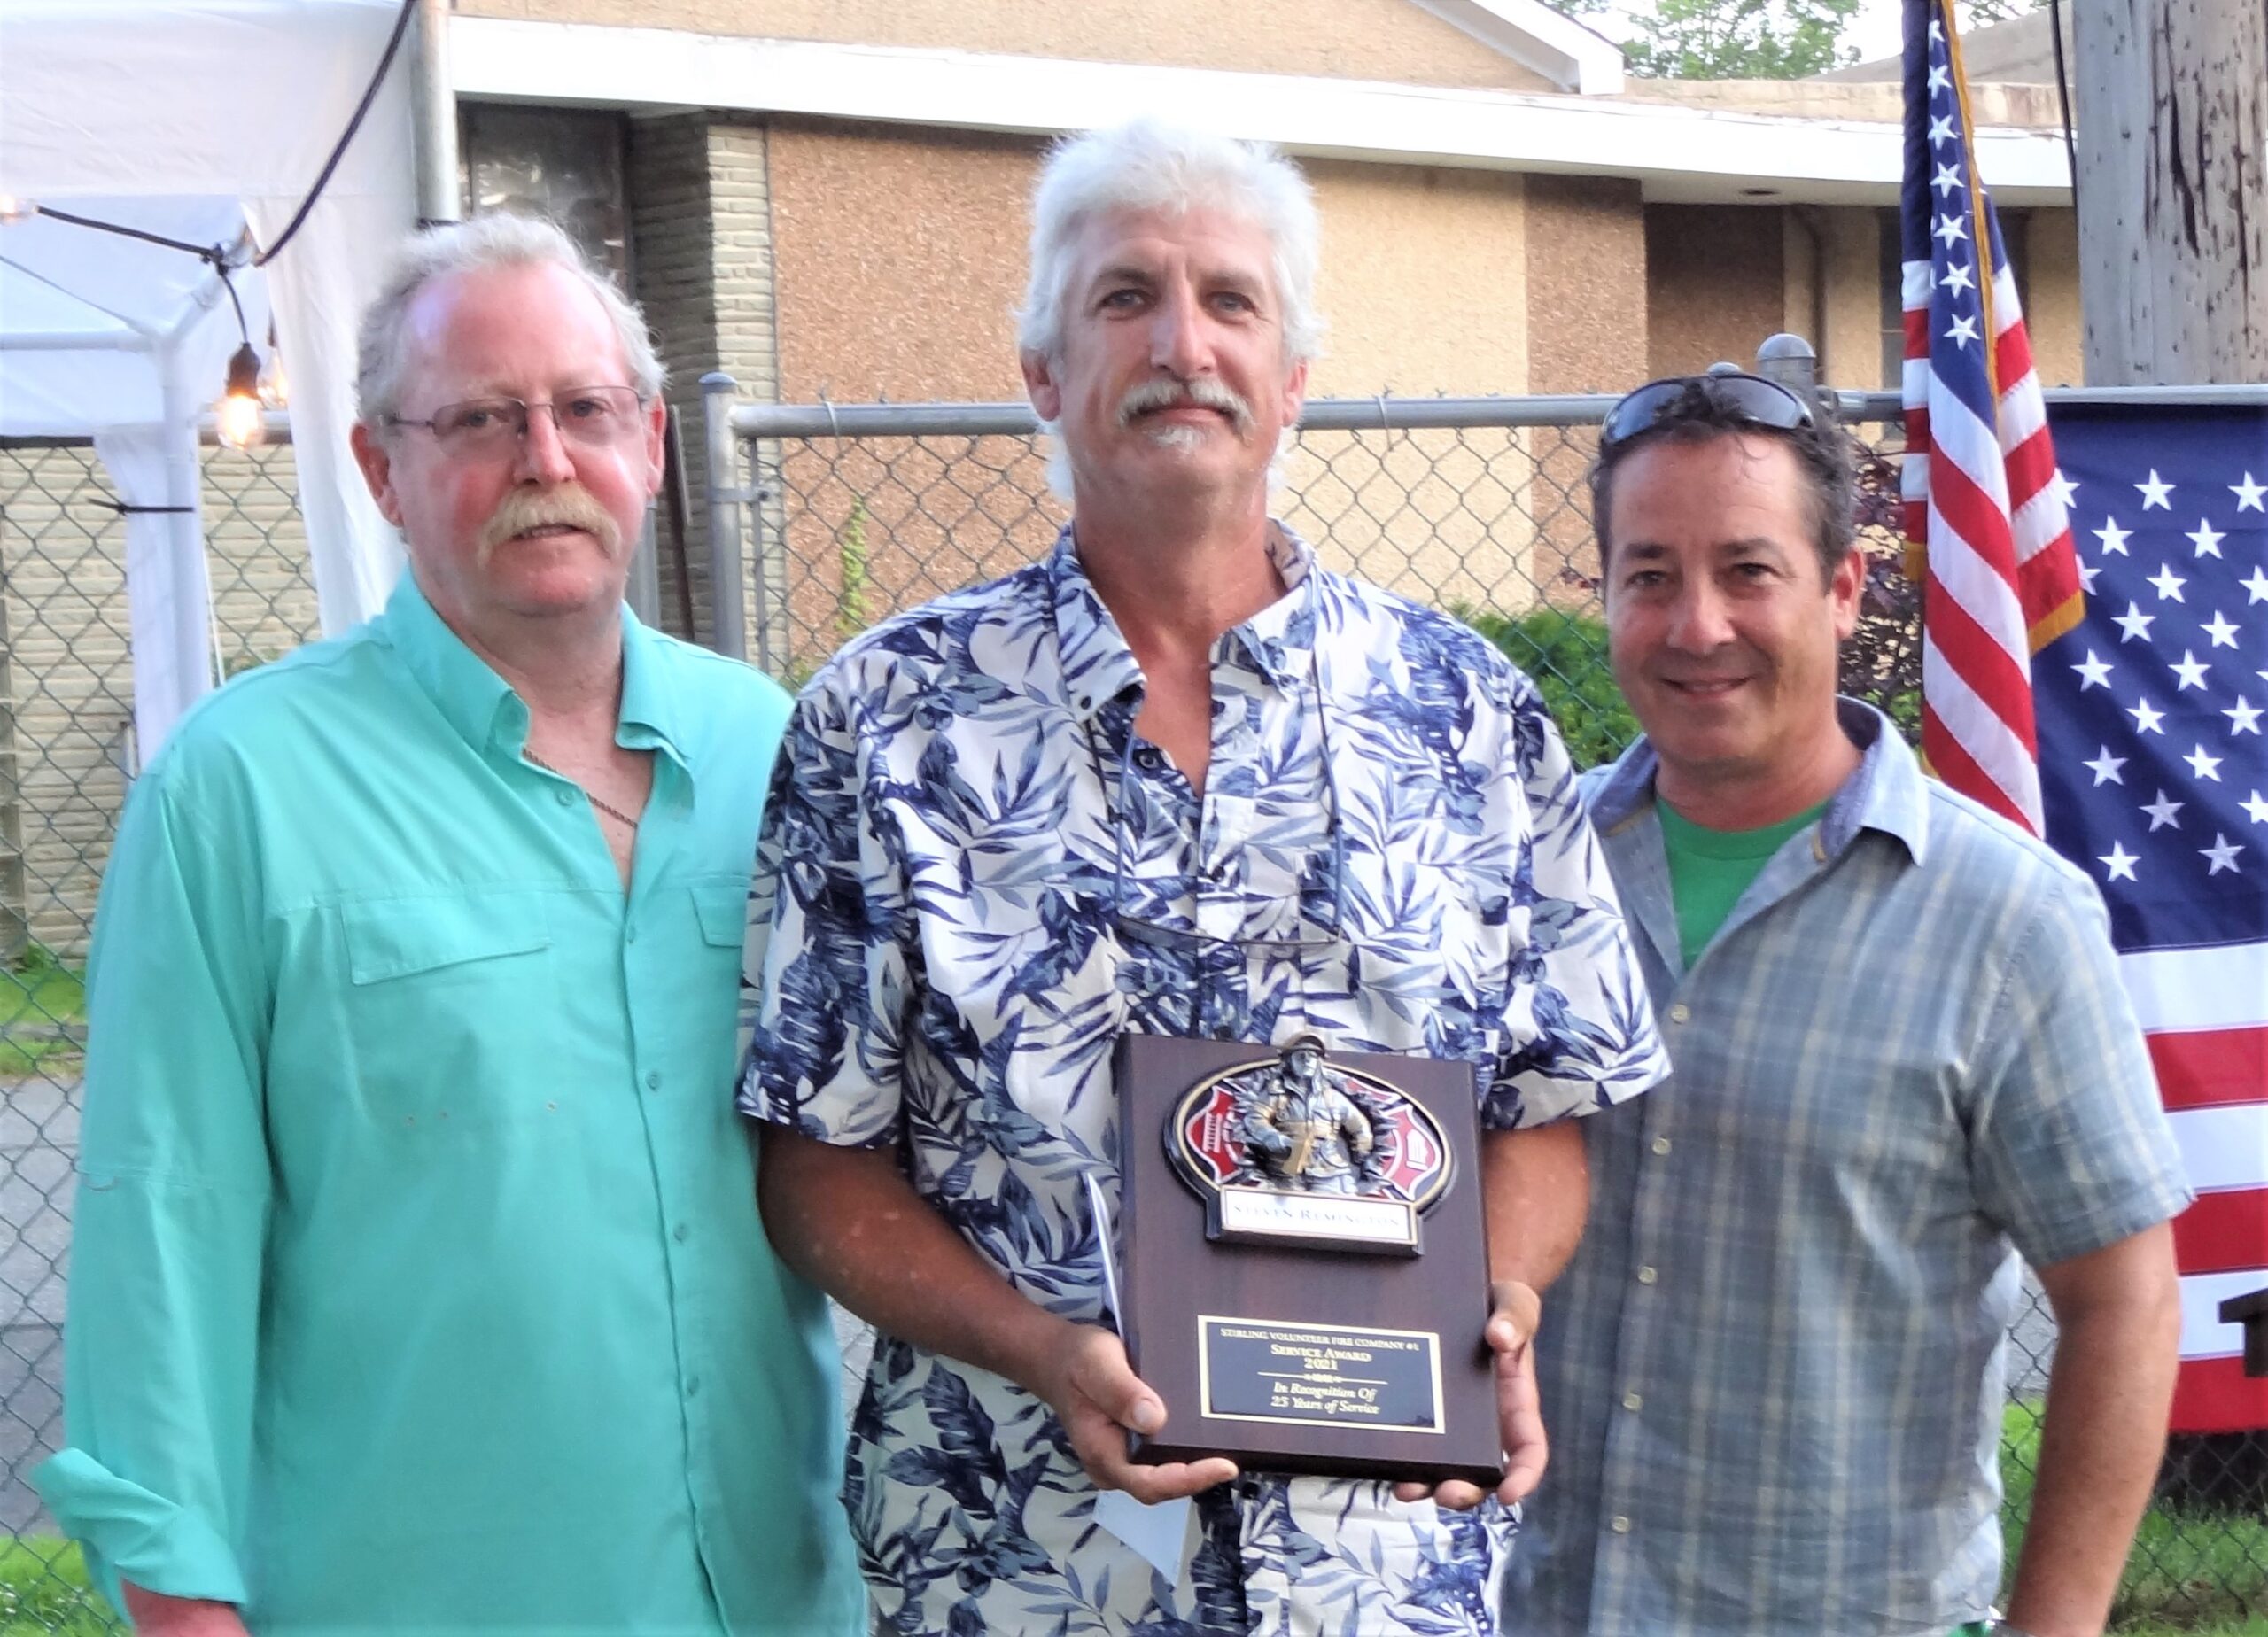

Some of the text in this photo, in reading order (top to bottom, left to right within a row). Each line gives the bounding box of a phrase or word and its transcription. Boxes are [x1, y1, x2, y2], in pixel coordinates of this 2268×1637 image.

[1270, 1331, 1330, 1345] VOLUNTEER
[1332, 1336, 1354, 1346] FIRE
[1355, 1338, 1405, 1350] COMPANY
[1270, 1344, 1372, 1362] SERVICE AWARD
[1303, 1357, 1339, 1370] 2021
[1273, 1382, 1378, 1401] In Recognition Of
[1270, 1396, 1380, 1415] 25 Years of Service
